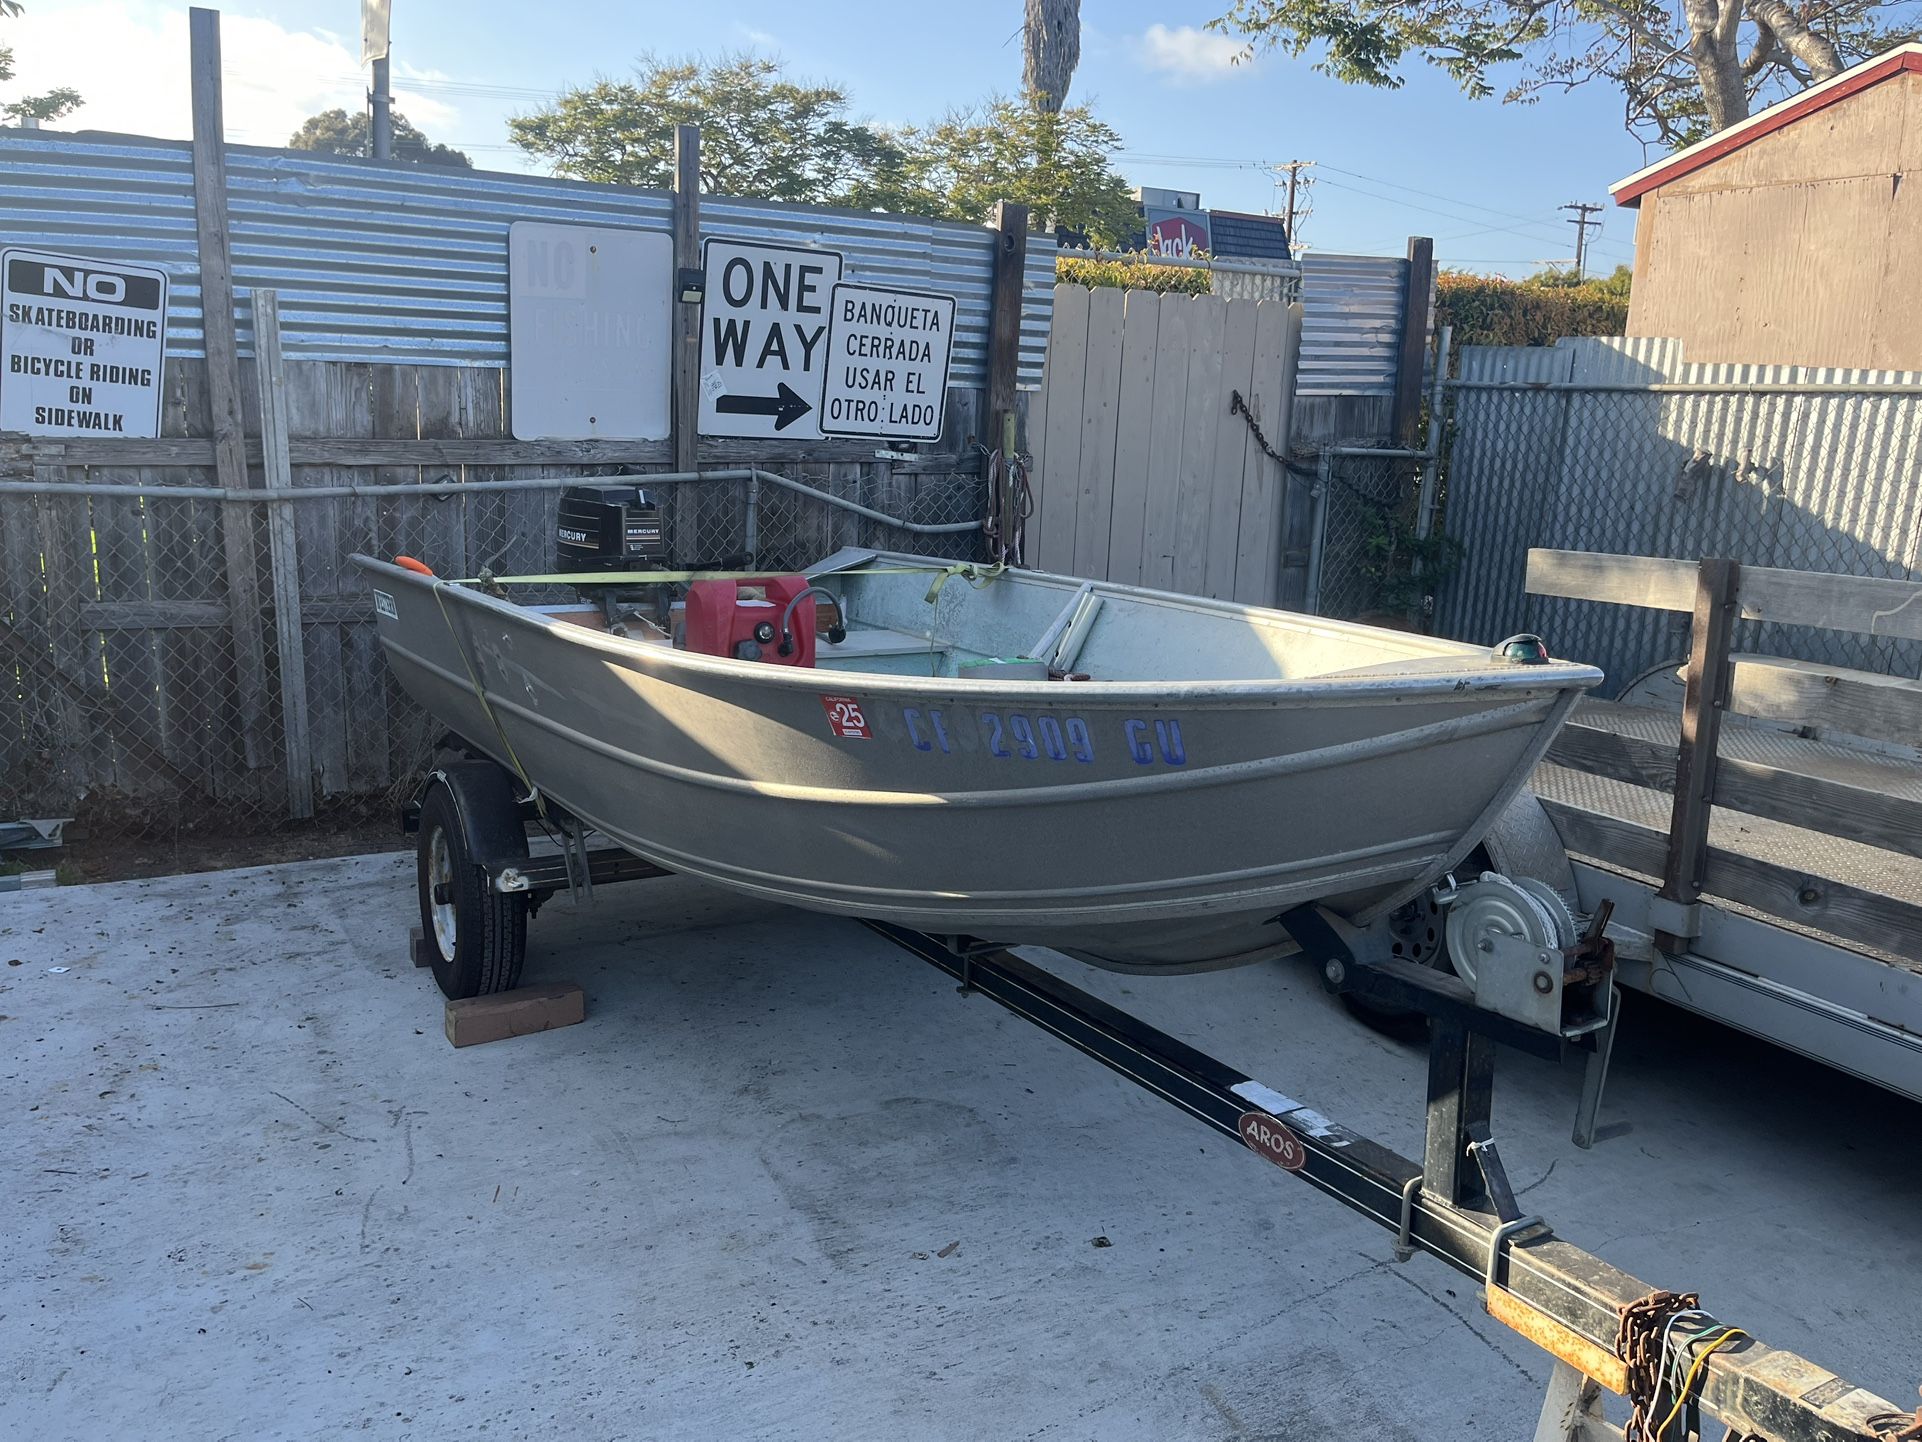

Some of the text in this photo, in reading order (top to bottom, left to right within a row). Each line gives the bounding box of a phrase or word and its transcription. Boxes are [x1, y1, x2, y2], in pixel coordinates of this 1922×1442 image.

[43, 267, 126, 303] NO
[722, 257, 823, 315] ONE
[9, 303, 157, 339] SKATEBOARDING
[843, 299, 940, 332] BANQUETA
[71, 336, 95, 356] OR
[713, 317, 826, 372] WAY
[846, 333, 932, 364] CERRADA
[10, 354, 152, 387] BICYCLE RIDING
[845, 366, 926, 395] USAR EL
[69, 385, 92, 405] ON
[35, 406, 124, 432] SIDEWALK
[830, 398, 934, 426] OTRO LADO
[558, 528, 587, 542] MERCURY
[835, 703, 865, 727] 25
[981, 712, 1094, 763] 2909
[1124, 718, 1187, 766] GU
[1246, 1120, 1294, 1160] AROS
